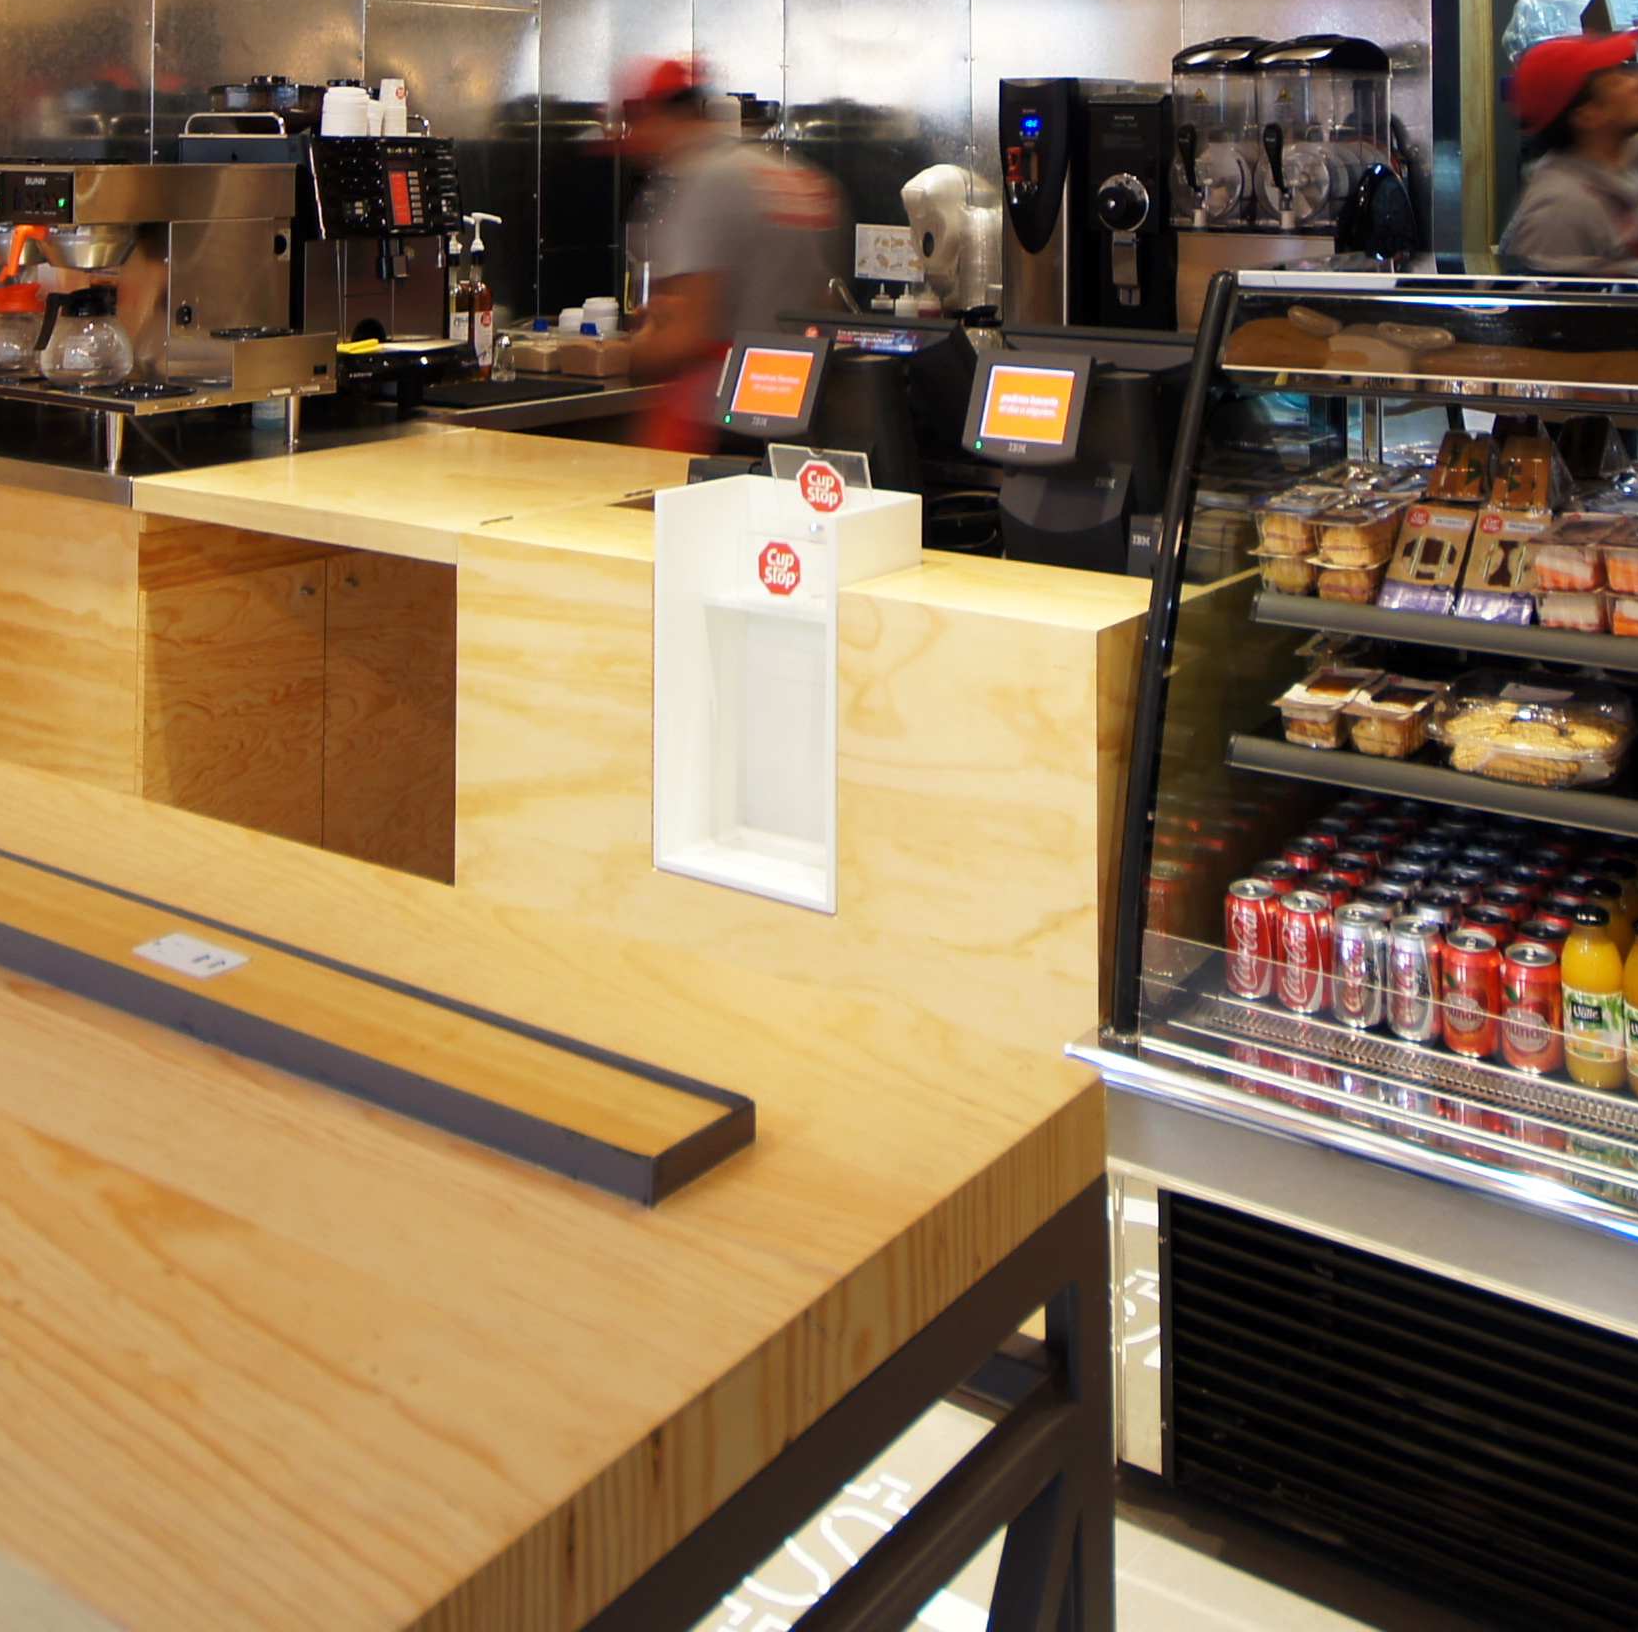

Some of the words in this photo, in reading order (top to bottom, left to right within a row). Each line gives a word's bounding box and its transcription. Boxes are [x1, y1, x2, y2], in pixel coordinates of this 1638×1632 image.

[25, 177, 47, 186] BUNN
[1008, 442, 1026, 454] IBM
[807, 470, 835, 491] Cup
[806, 486, 839, 508] Stop
[1133, 534, 1151, 547] IBM
[766, 548, 795, 571] Cup
[764, 565, 796, 590] Stop
